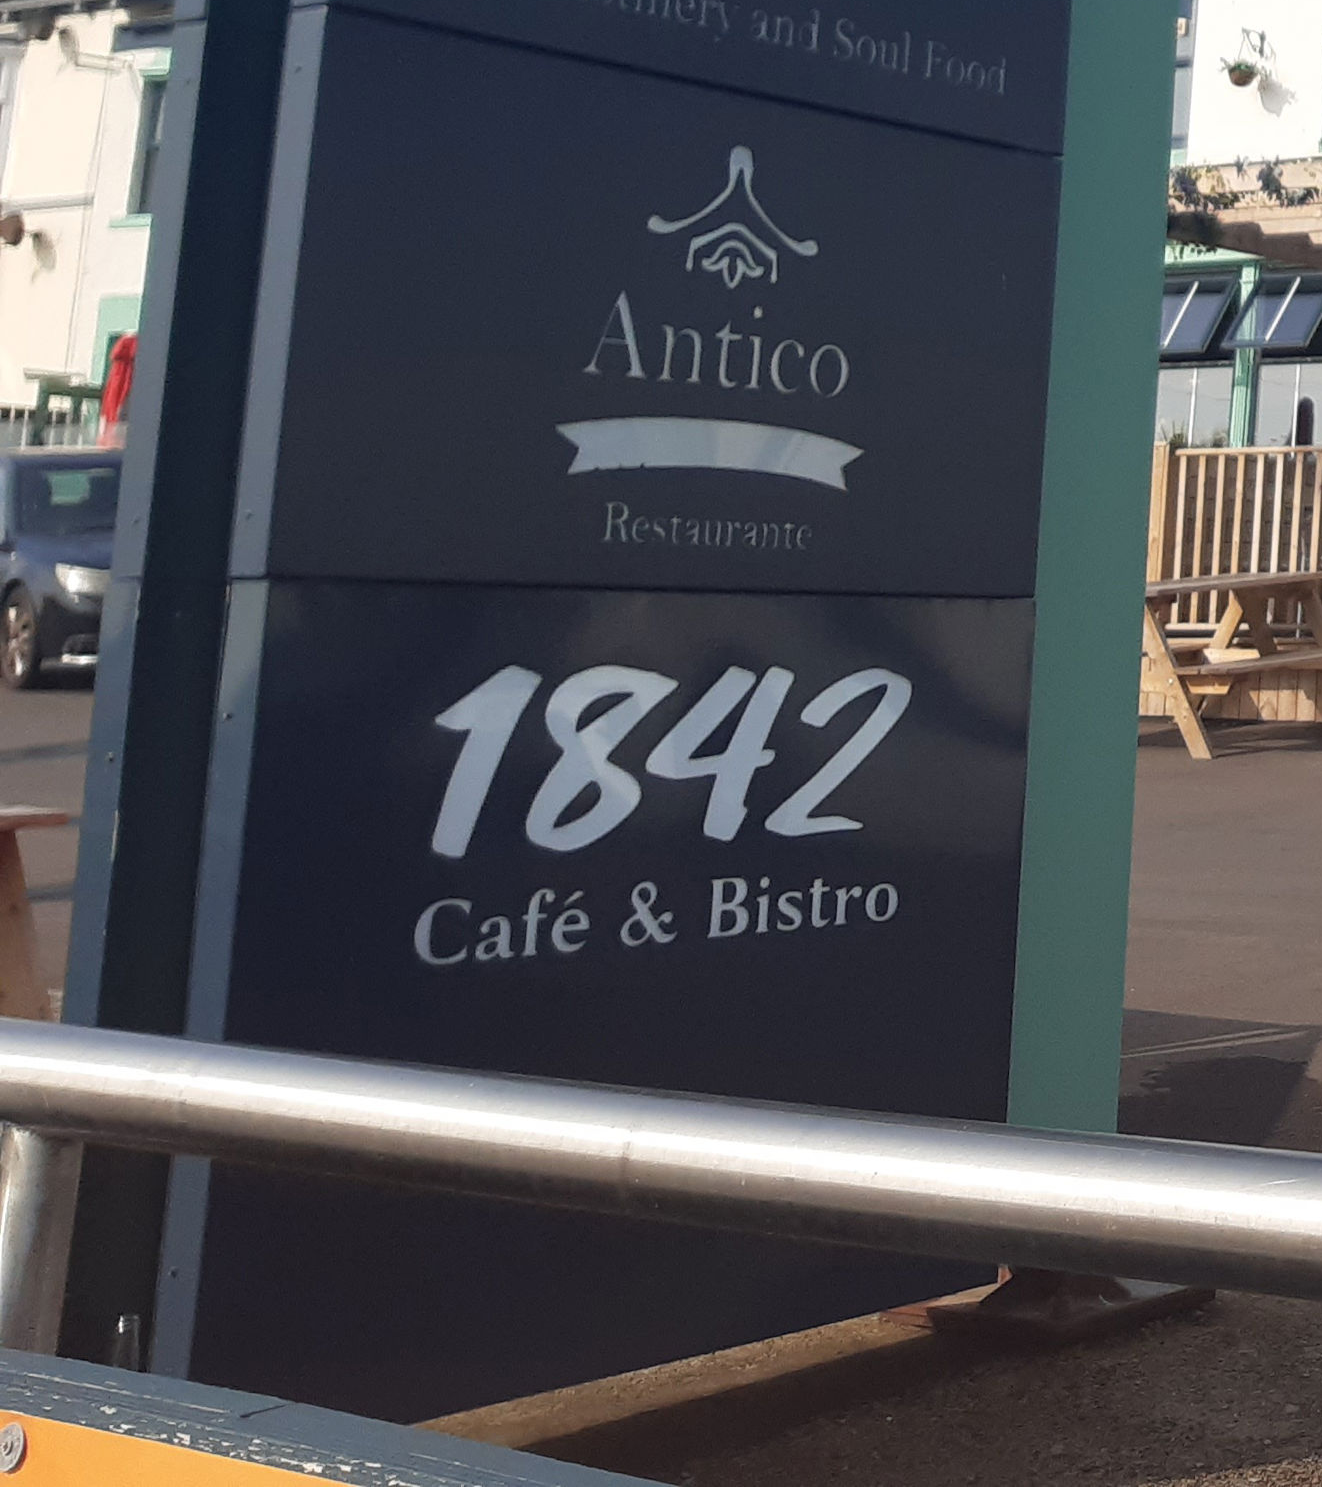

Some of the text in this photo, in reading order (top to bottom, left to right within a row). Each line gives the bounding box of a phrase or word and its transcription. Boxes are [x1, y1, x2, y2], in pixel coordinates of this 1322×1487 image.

[749, 9, 821, 52] and
[833, 18, 912, 74] Soul
[923, 40, 1008, 96] Food
[583, 291, 850, 399] Antico
[602, 501, 813, 551] Restaurante
[430, 664, 913, 858] 1842
[412, 874, 899, 965] Café & Bistro
